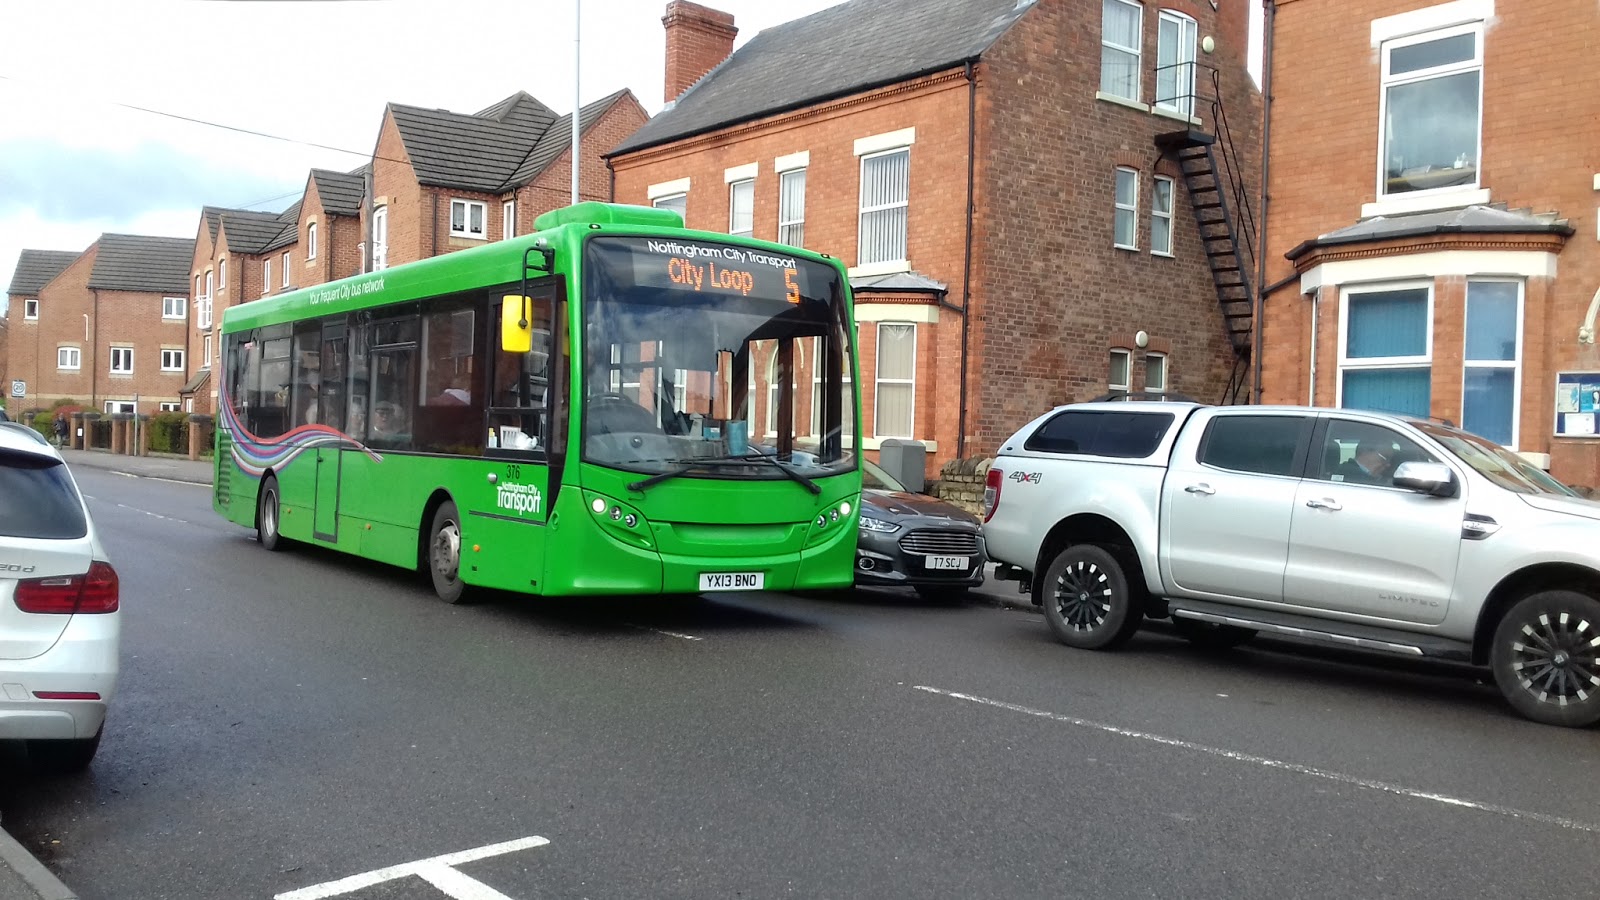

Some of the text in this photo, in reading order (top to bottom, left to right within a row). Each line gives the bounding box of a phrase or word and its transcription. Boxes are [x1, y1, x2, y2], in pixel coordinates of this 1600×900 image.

[648, 240, 796, 269] Nottingham City Transport
[309, 276, 384, 304] Your frequent City bus network
[668, 257, 800, 304] City Loop 5
[506, 464, 521, 480] 376
[501, 481, 538, 496] Nottingham City
[497, 485, 541, 516] Transport
[934, 557, 961, 569] T7 SCJ
[707, 574, 757, 587] YX13 BNO
